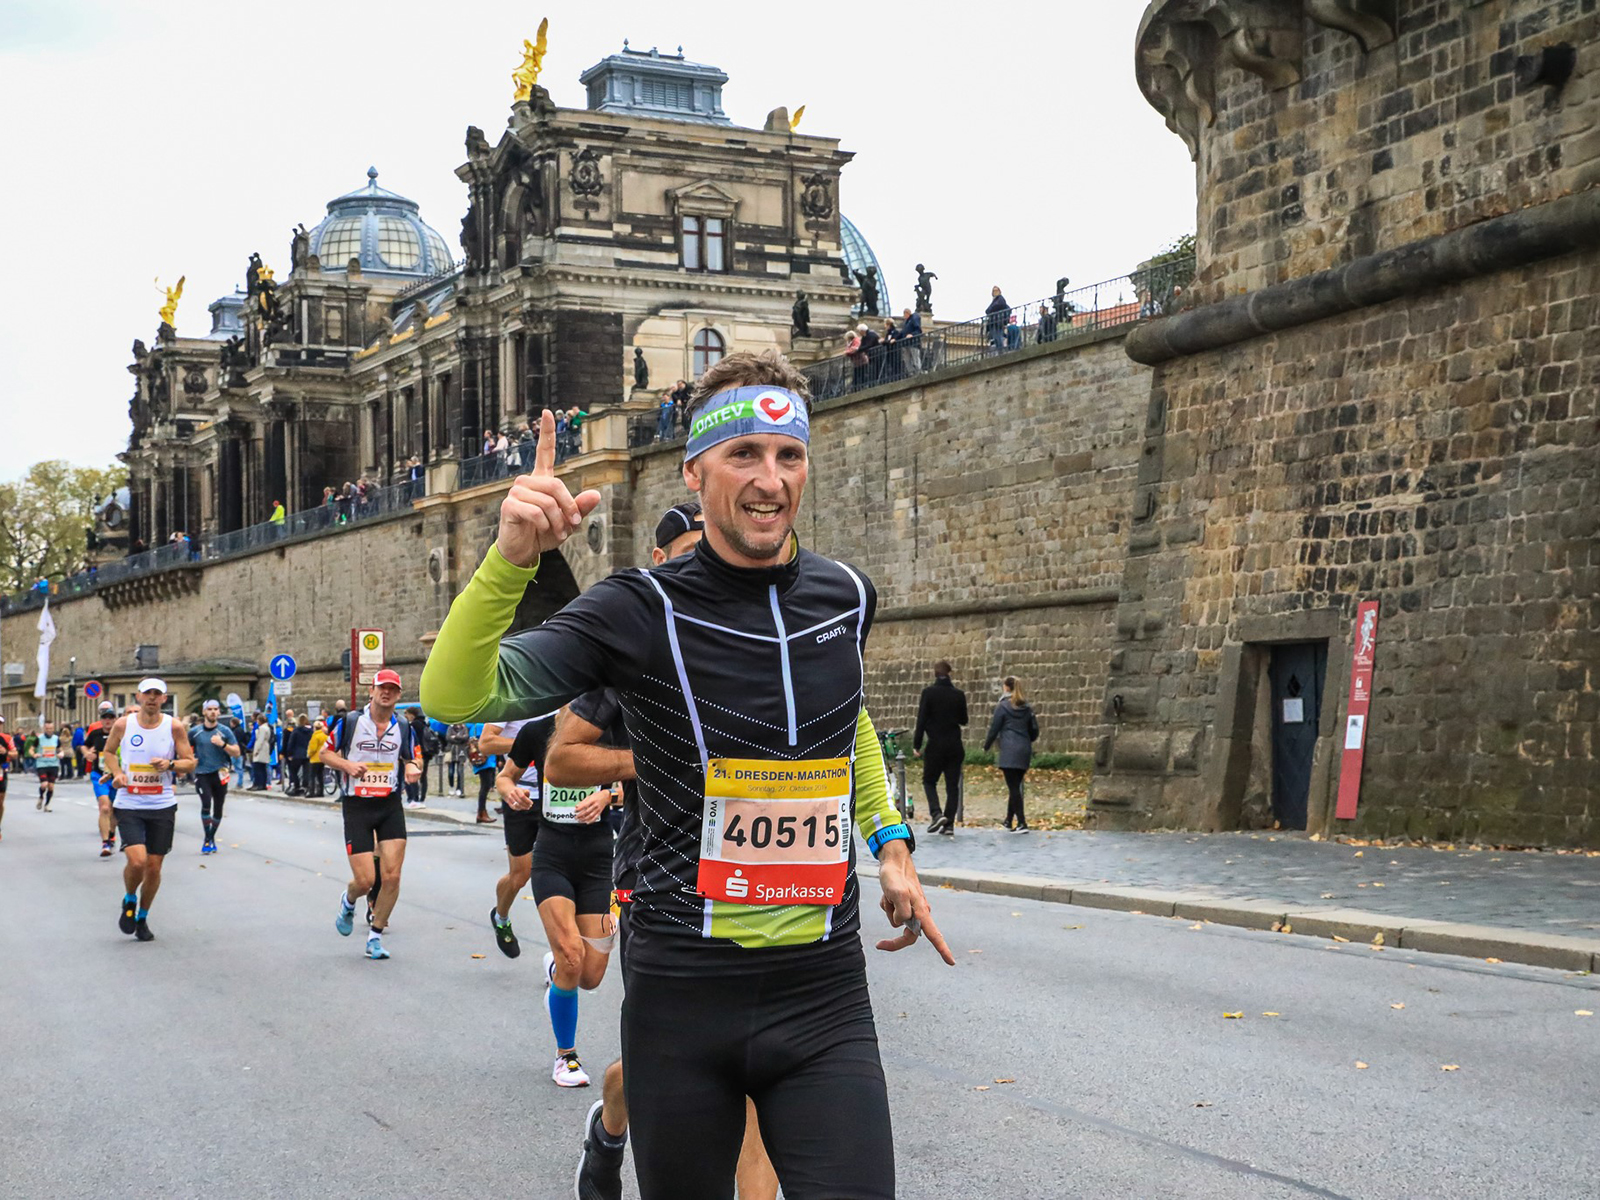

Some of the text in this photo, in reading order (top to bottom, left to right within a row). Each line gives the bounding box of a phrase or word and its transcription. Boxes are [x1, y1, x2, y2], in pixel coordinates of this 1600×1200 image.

[696, 403, 746, 434] DATEV
[816, 627, 842, 644] CRAFT
[360, 775, 389, 783] 41312
[713, 768, 847, 781] 21. DRESDEN-MARATHON
[723, 814, 839, 848] 40515
[755, 883, 834, 901] Sparkasse
